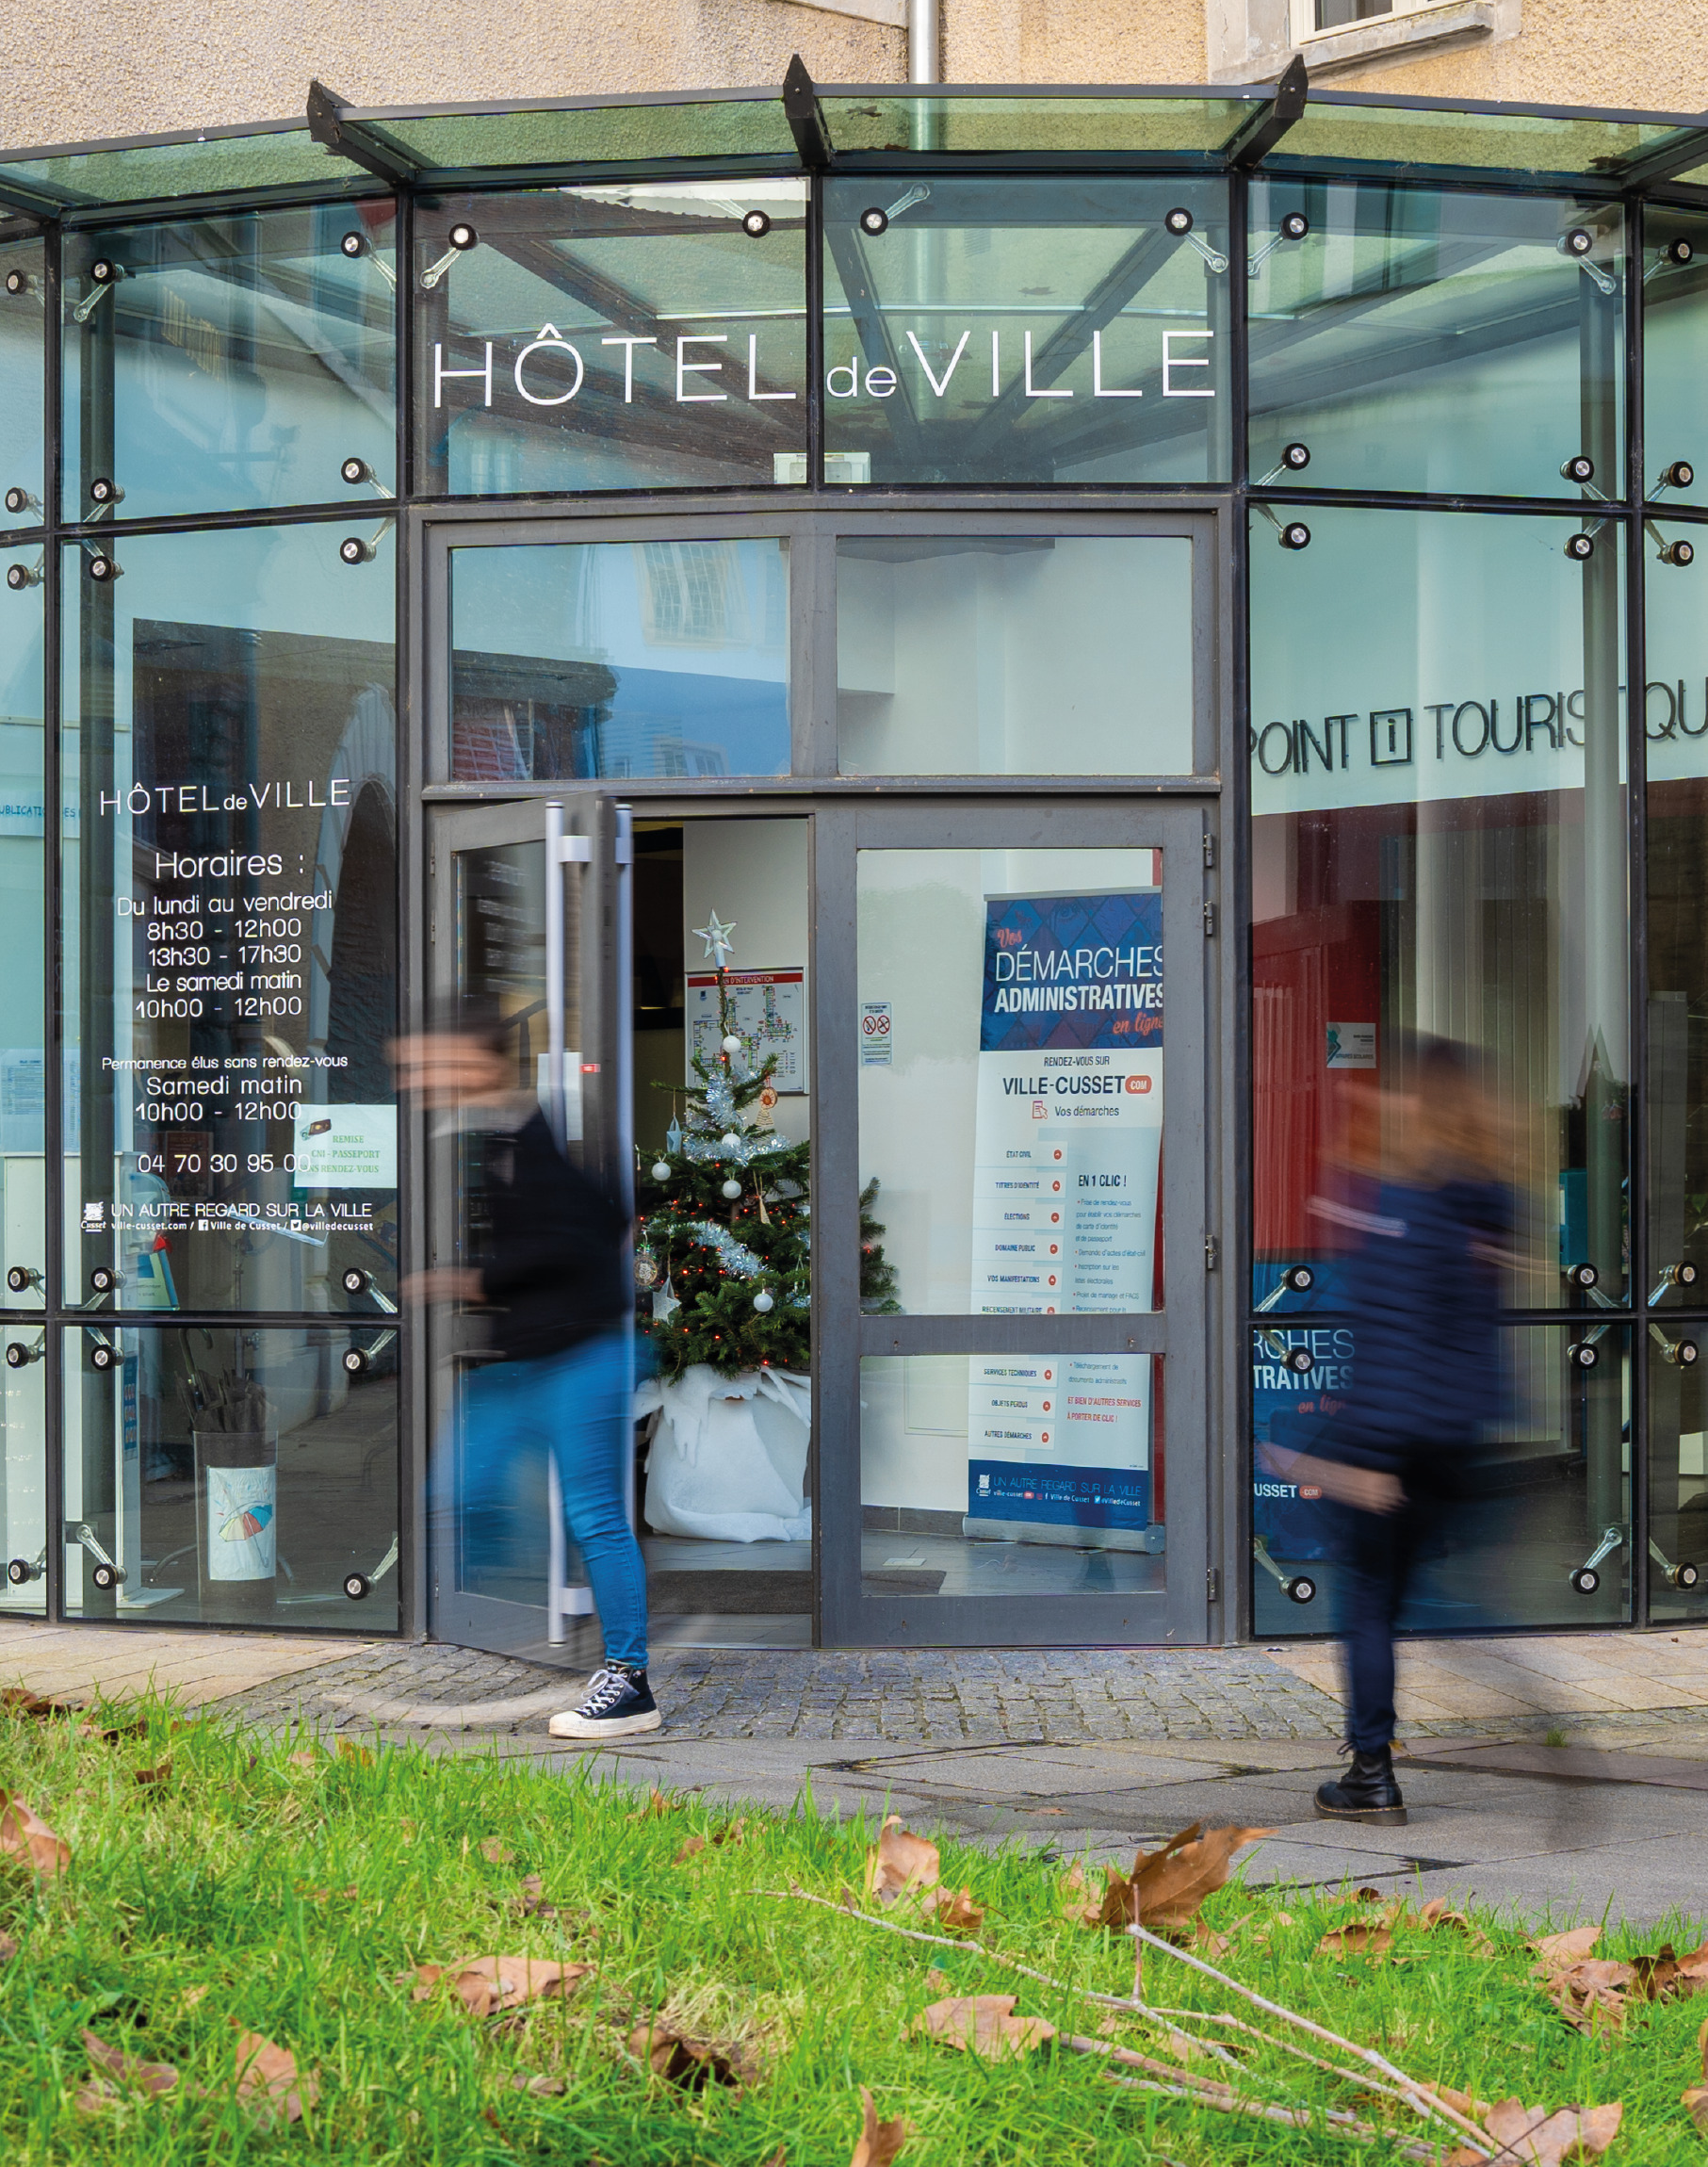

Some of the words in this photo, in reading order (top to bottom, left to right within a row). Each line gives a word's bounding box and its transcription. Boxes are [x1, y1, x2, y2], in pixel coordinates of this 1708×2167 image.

[434, 323, 796, 408] HÔTEL
[825, 356, 897, 398] de
[906, 331, 1215, 397] VILLE
[100, 782, 220, 817] HÔTEL
[223, 794, 248, 810] de
[249, 779, 350, 809] VILLE
[0, 805, 44, 817] UBLICATI
[155, 849, 283, 879] Horaires
[299, 854, 304, 873] :
[117, 897, 145, 916] Du
[154, 895, 200, 915] lundi
[208, 897, 235, 913] au
[243, 890, 332, 912] vendredi
[147, 921, 203, 941] 8h30
[235, 918, 301, 938] 12h00
[148, 946, 211, 967] 13h30
[237, 944, 301, 964] 17h30
[146, 974, 171, 993] Le
[176, 971, 244, 991] samedi
[251, 969, 301, 989] matin
[135, 998, 203, 1018] 10h00
[235, 996, 302, 1017] 12h00
[1113, 1019, 1131, 1035] en
[102, 1057, 187, 1070] Permanence
[191, 1055, 219, 1069] élus
[224, 1058, 257, 1068] sans
[262, 1054, 349, 1068] rendez-vous
[1044, 1055, 1094, 1067] RENDEZ-VOUS
[1096, 1055, 1110, 1066] SUR
[146, 1075, 230, 1096] Samedi
[241, 1074, 302, 1094] matin
[1002, 1075, 1126, 1095] VILLE-CUSSET
[135, 1101, 203, 1122] 10h00
[235, 1100, 302, 1121] 12h00
[1054, 1105, 1071, 1116] Vos
[1073, 1104, 1119, 1116] démarches
[333, 1135, 365, 1144] REMISE
[138, 1153, 165, 1174] 04
[174, 1153, 202, 1174] 70
[210, 1153, 237, 1174] 30
[247, 1153, 274, 1174] 95
[284, 1153, 311, 1173] 00
[332, 1150, 381, 1159] PASSEPORT
[320, 1165, 380, 1173] RENDEZ-VOUS
[1079, 1175, 1089, 1186] EN
[1092, 1175, 1096, 1186] 1
[1099, 1175, 1120, 1186] CLIC
[111, 1203, 134, 1217] UN
[138, 1203, 190, 1217] AUTRE
[195, 1202, 261, 1217] REGARD
[266, 1202, 299, 1217] SUR
[305, 1202, 325, 1217] LA
[331, 1202, 373, 1217] VILLE
[111, 1221, 187, 1230] ville-cusset.com
[210, 1221, 232, 1230] Ville
[236, 1221, 246, 1230] de
[249, 1221, 281, 1230] Cusset
[301, 1221, 374, 1231] @villedecusset
[993, 1476, 1007, 1487] UN
[1009, 1477, 1037, 1489] AUTRE
[1041, 1479, 1076, 1491] REGARD
[1081, 1482, 1100, 1493] SUR
[1103, 1484, 1115, 1494] LA
